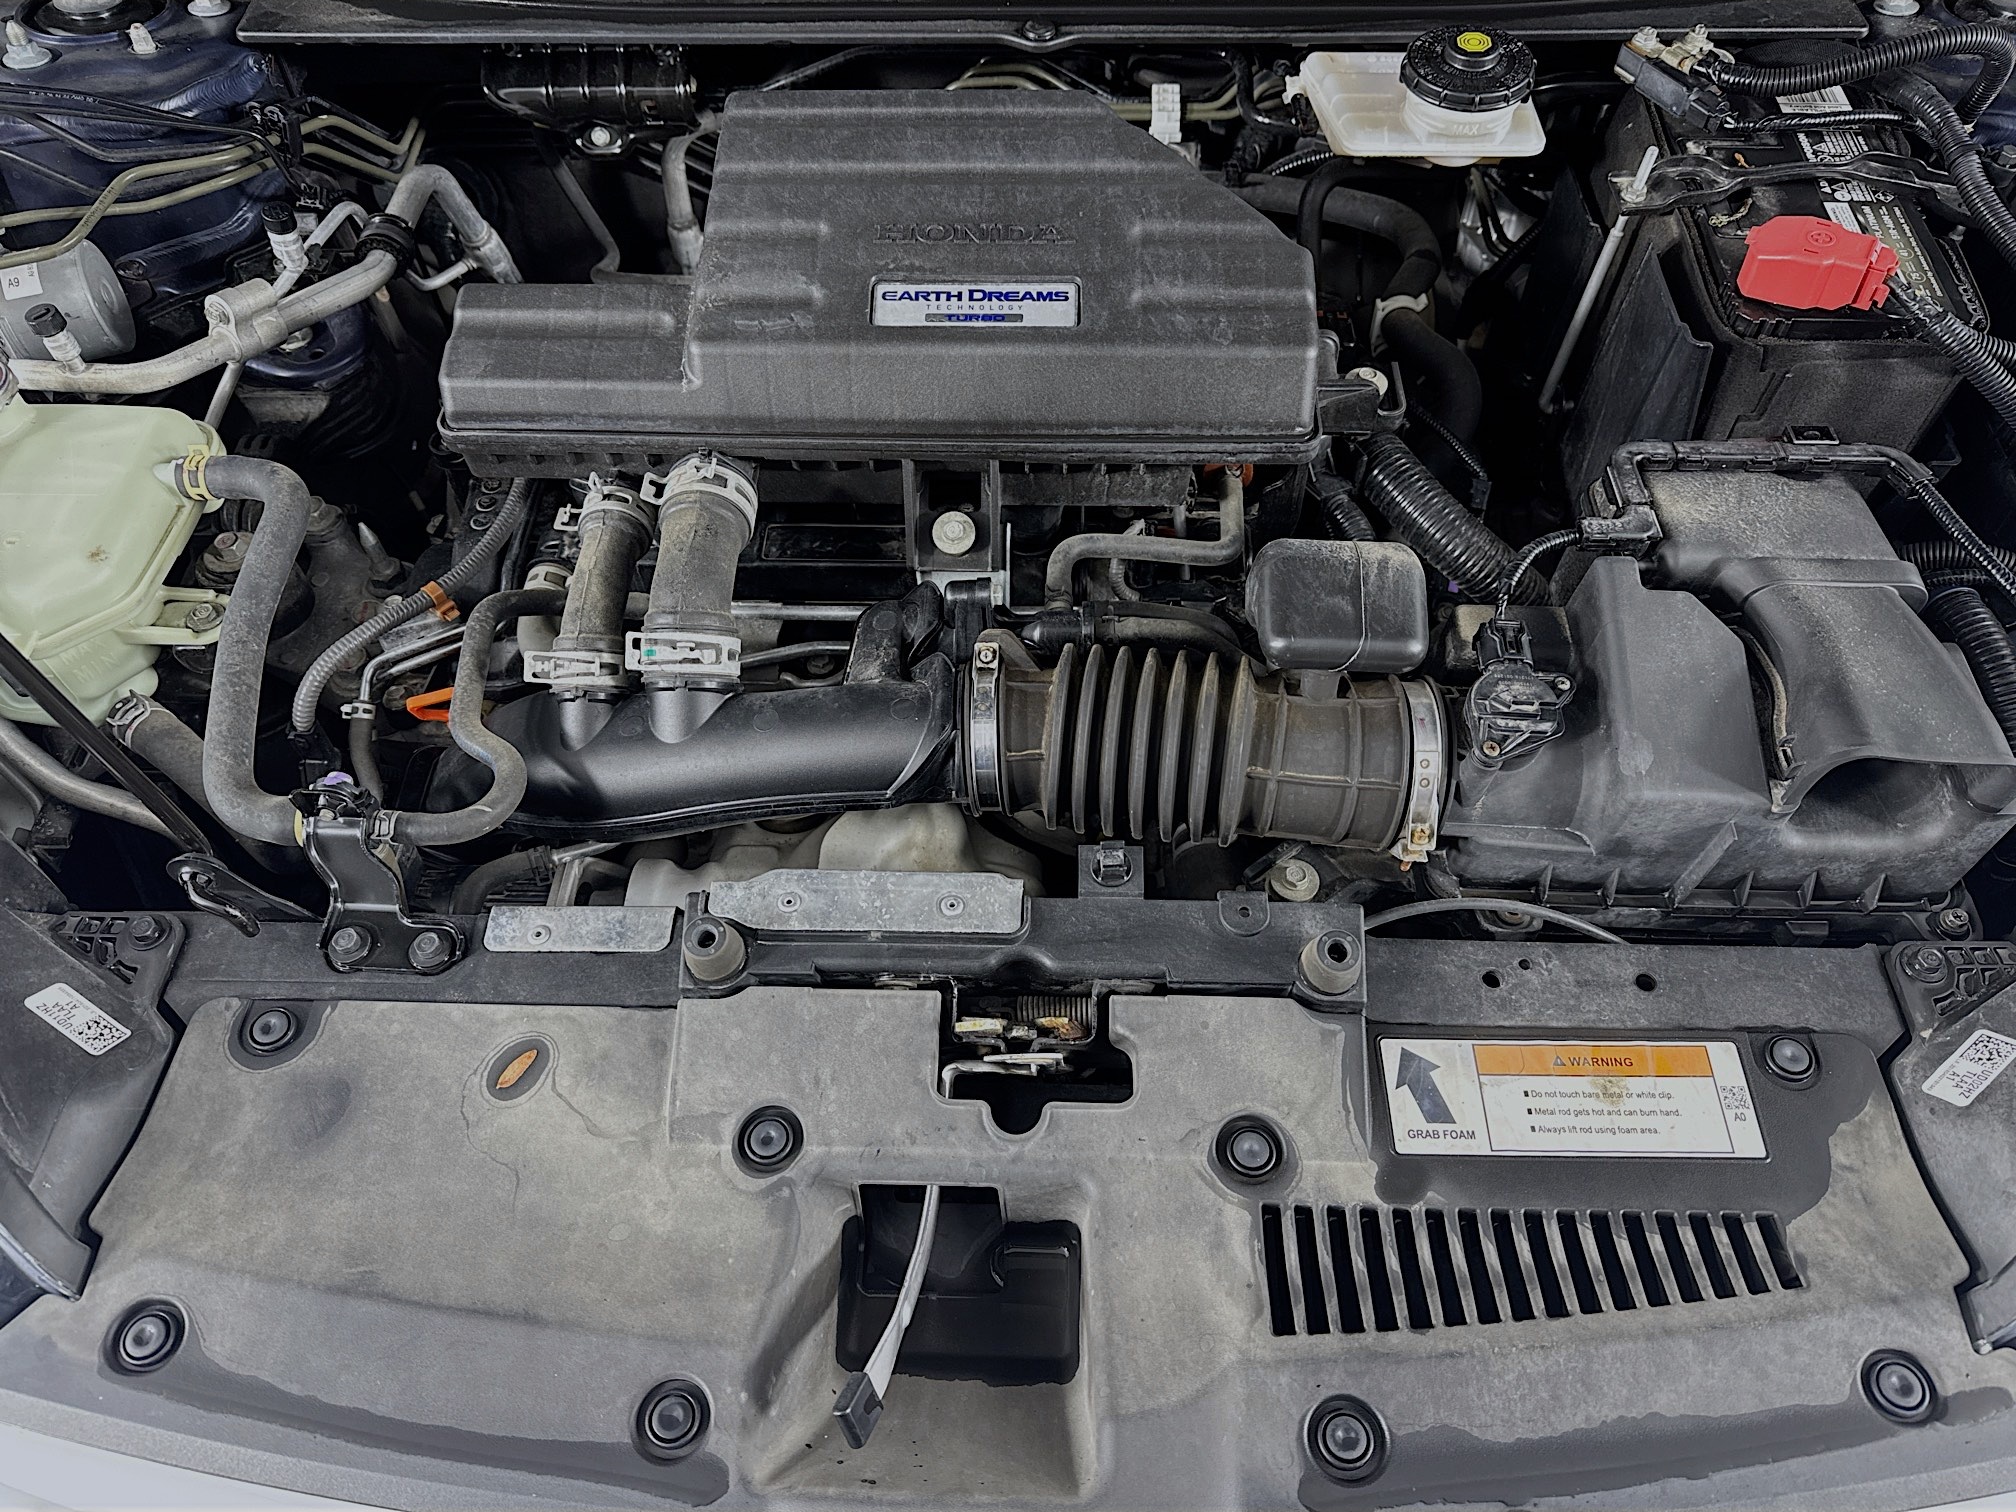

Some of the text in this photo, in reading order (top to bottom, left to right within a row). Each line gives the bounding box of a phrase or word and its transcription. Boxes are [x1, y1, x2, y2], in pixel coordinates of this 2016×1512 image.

[1453, 124, 1479, 136] MAX
[1861, 205, 1884, 239] PLATINUM
[873, 223, 1077, 244] HONDA
[8, 277, 20, 289] A9
[881, 289, 1070, 302] EARTH DREAMS
[944, 313, 1006, 322] TURBO
[72, 652, 118, 683] MIN
[52, 1001, 76, 1020] TLAA
[65, 1000, 80, 1009] A1
[36, 1002, 73, 1030] UD11HZ
[1568, 1056, 1634, 1067] WARNING
[1946, 1070, 1960, 1081] A1
[1952, 1070, 1977, 1089] TLAA
[1959, 1069, 1994, 1099] UD02HZ
[1530, 1089, 1543, 1098] Do
[1544, 1090, 1558, 1098] not
[1559, 1090, 1581, 1098] touch
[1582, 1090, 1601, 1099] bare
[1602, 1091, 1624, 1099] metal
[1636, 1091, 1657, 1099] white
[1658, 1091, 1675, 1100] clip.
[1534, 1107, 1557, 1116] Metal
[1558, 1108, 1572, 1116] rod
[1573, 1108, 1590, 1117] gets
[1591, 1108, 1605, 1116] hot
[1639, 1108, 1658, 1117] burn
[1659, 1109, 1683, 1117] hand.
[1407, 1129, 1476, 1140] GRAB FOAM
[1538, 1125, 1567, 1135] Always
[1567, 1125, 1578, 1134] lift
[1579, 1126, 1593, 1134] rod
[1594, 1126, 1616, 1135] using
[1617, 1126, 1639, 1134] foam
